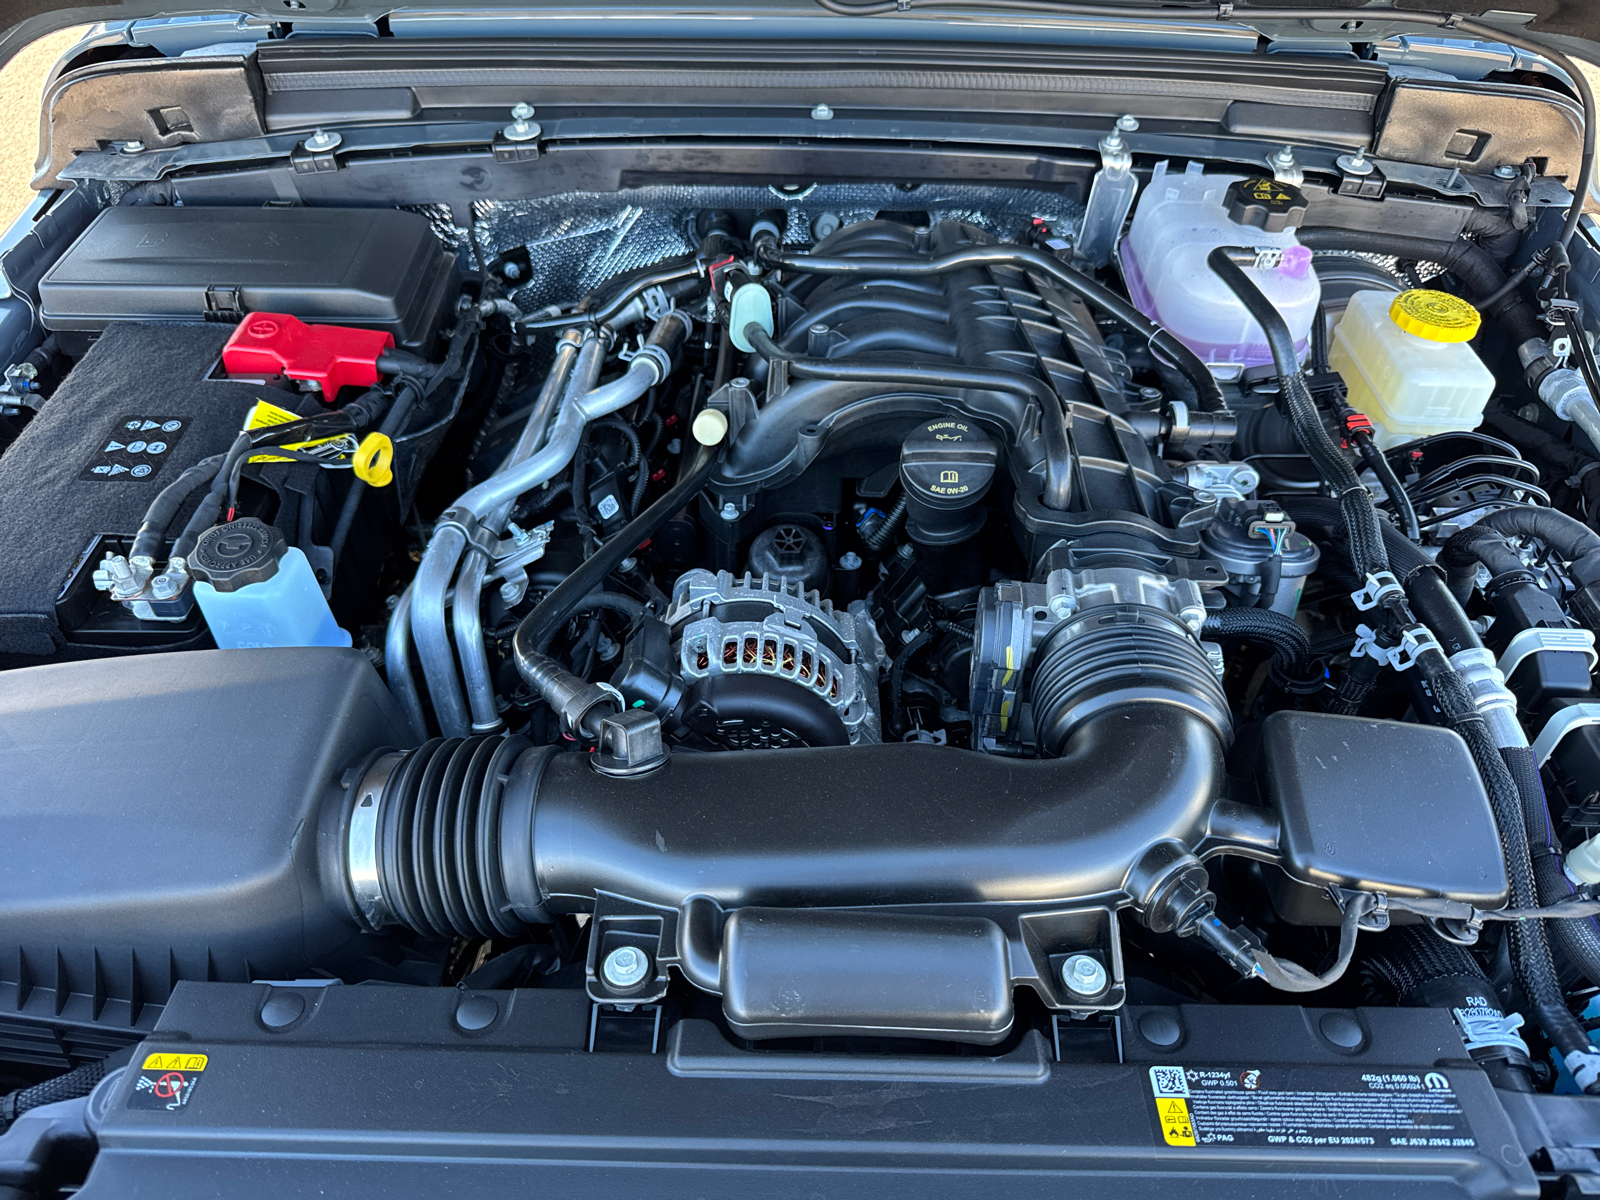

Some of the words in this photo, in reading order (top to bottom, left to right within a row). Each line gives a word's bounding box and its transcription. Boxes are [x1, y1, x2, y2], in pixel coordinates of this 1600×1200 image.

[927, 422, 955, 432] ENGINE
[957, 423, 968, 432] OIL
[930, 484, 945, 494] SAE
[947, 485, 968, 494] 0W-20
[221, 522, 259, 531] STEERING
[203, 530, 220, 546] FLUID
[200, 553, 237, 569] APPROVED
[240, 554, 257, 565] USE
[1466, 996, 1487, 1006] RAD
[1199, 1071, 1231, 1080] R-1234yf
[1361, 1074, 1382, 1083] 482g
[1408, 1074, 1420, 1083] lb)
[1216, 1134, 1234, 1142] PAG
[1267, 1135, 1287, 1143] GWP
[1296, 1136, 1313, 1144] CO2
[1314, 1137, 1327, 1145] per
[1328, 1136, 1340, 1144] EU
[1390, 1137, 1408, 1146] SAE
